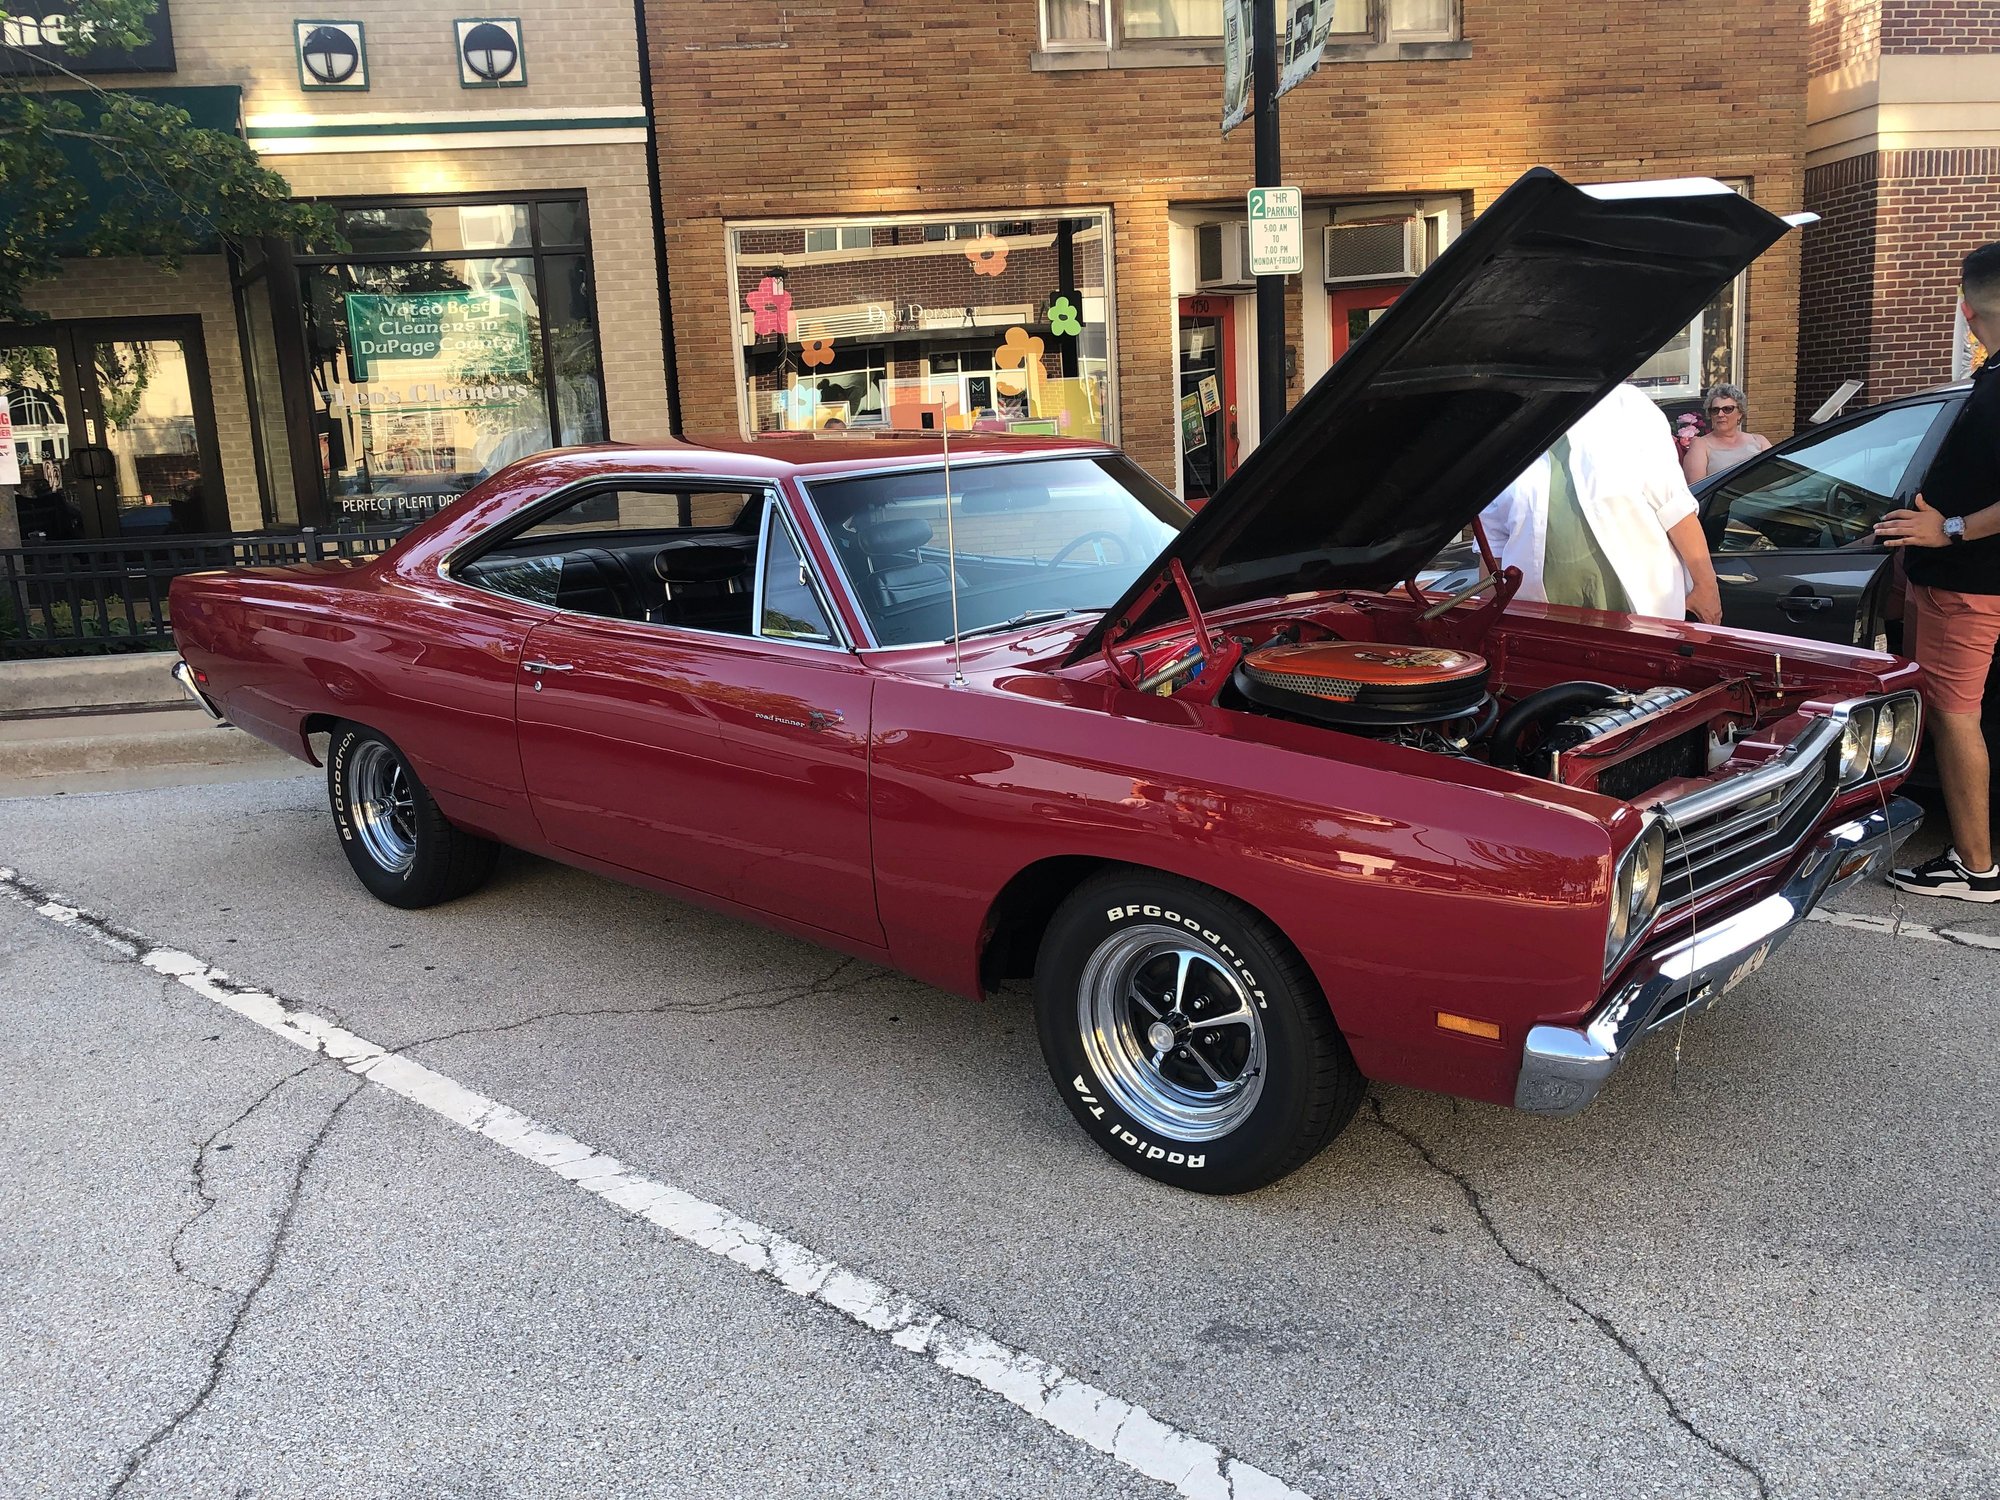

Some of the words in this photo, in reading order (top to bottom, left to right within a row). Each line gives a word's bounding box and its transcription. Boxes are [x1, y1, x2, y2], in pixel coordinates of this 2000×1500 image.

[1252, 195, 1264, 217] 2
[1275, 192, 1288, 204] HR
[1267, 206, 1298, 217] PARKING
[1279, 223, 1288, 232] AM
[1272, 234, 1280, 243] TO
[1280, 245, 1289, 254] PM
[1254, 255, 1300, 266] MONDAY-FRIDAY
[383, 300, 443, 317] Voted
[447, 300, 491, 315] Best
[379, 321, 476, 336] Cleaners
[481, 319, 498, 331] in
[0, 347, 31, 363] 752
[361, 339, 435, 357] DuPage
[409, 383, 530, 403] Cleaners
[342, 498, 392, 512] PERFECT
[398, 495, 434, 509] PLEAT
[755, 712, 774, 722] road
[774, 715, 806, 728] runner
[335, 731, 356, 841] BFGoodrich
[1106, 904, 1268, 1009] BFGoodrich
[1072, 1074, 1106, 1121] T/A
[1109, 1123, 1206, 1169] Radial
